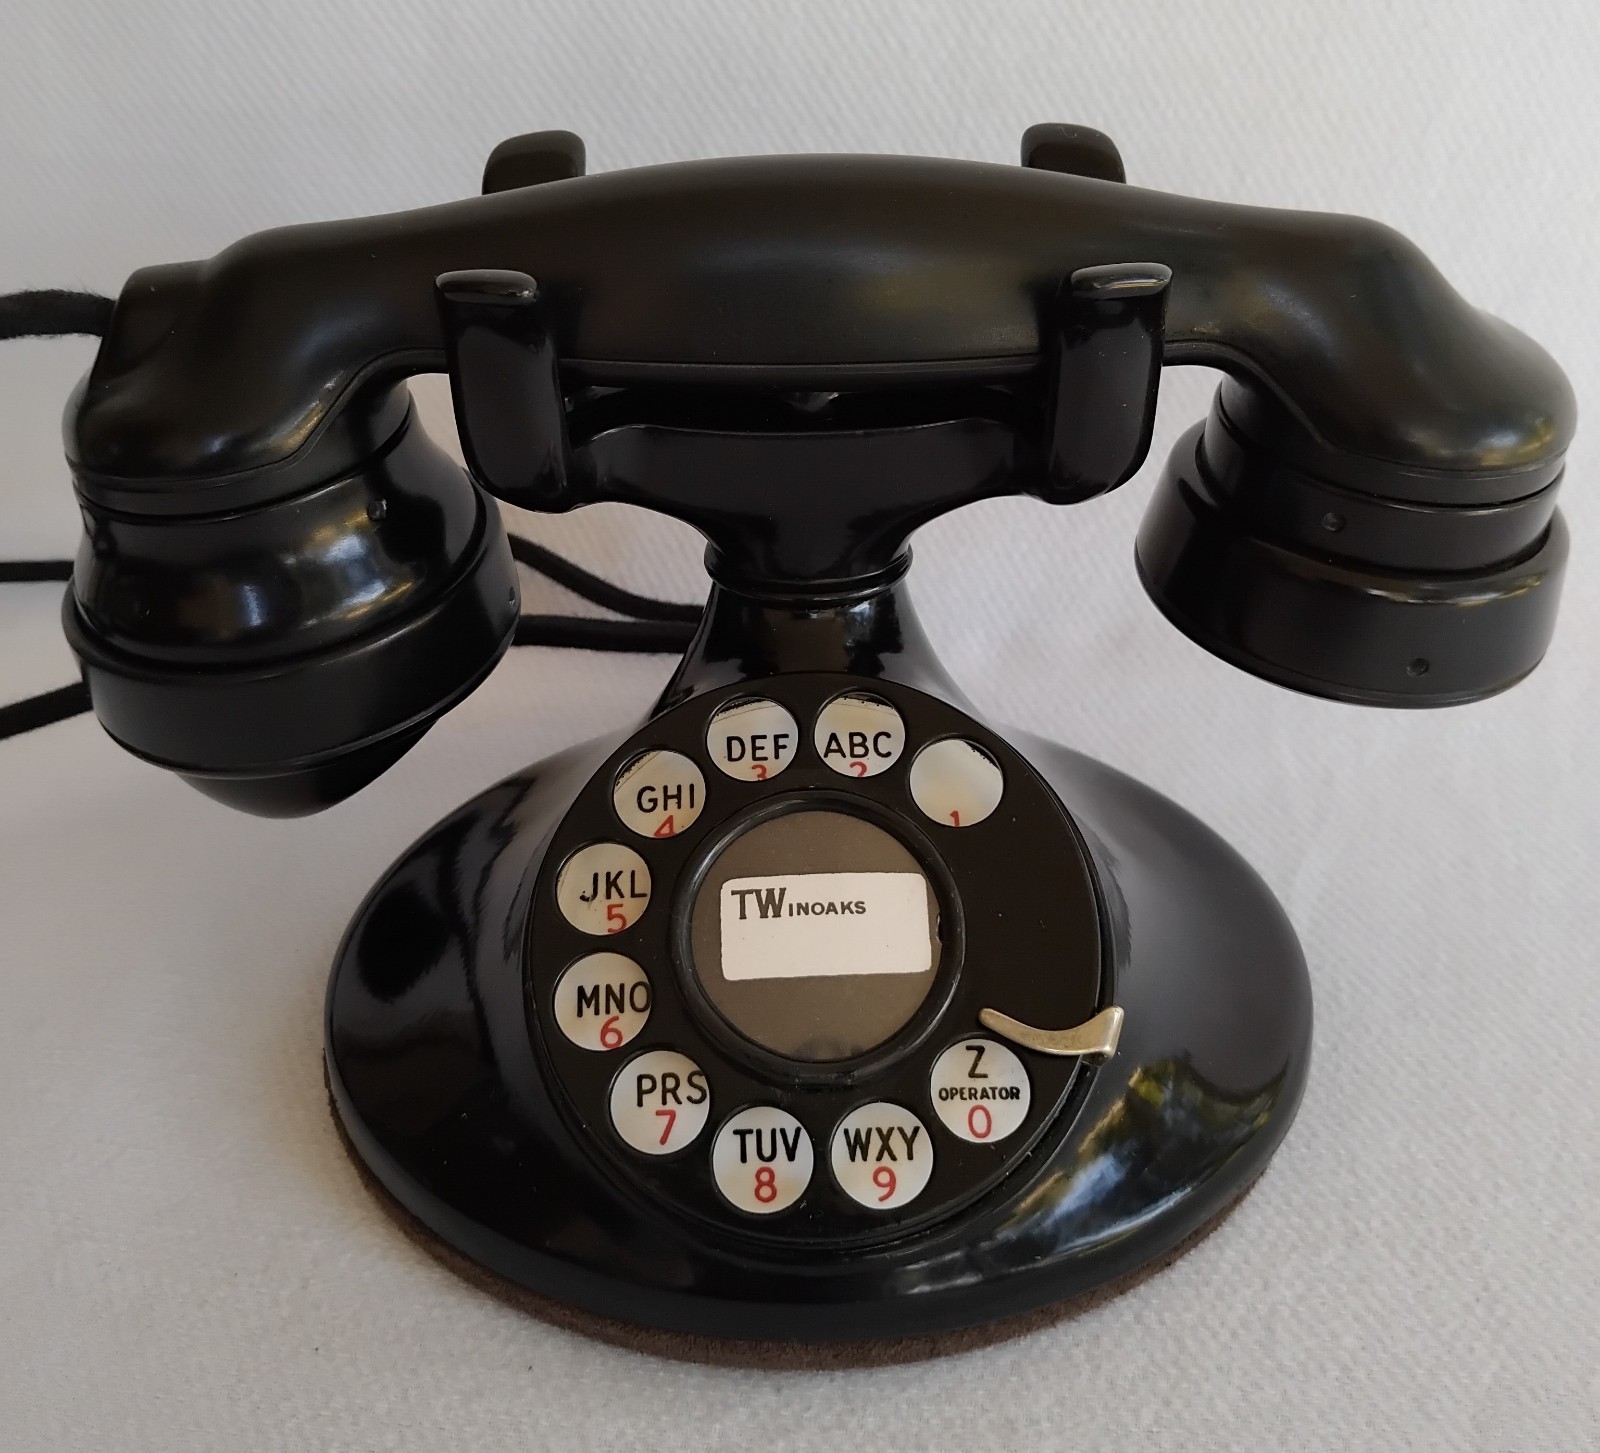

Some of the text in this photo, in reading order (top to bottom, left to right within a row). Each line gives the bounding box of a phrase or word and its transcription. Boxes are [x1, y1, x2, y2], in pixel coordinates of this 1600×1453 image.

[726, 734, 790, 762] DEF
[823, 731, 892, 758] ABC
[637, 783, 696, 813] GHI
[653, 815, 675, 838] 4
[950, 811, 959, 827] 1
[580, 870, 648, 902] JKL
[606, 903, 627, 933] 5
[731, 888, 866, 920] TWINOAKS
[577, 981, 651, 1017] MNO
[600, 1016, 622, 1048] 6
[966, 1045, 988, 1079] Z
[637, 1070, 707, 1107] PRS
[939, 1086, 1020, 1101] OPERATOR
[655, 1110, 677, 1145] 7
[968, 1105, 992, 1139] 0
[733, 1127, 801, 1163] TUV
[843, 1126, 920, 1161] WXY
[754, 1167, 777, 1203] 8
[873, 1166, 897, 1201] 9
